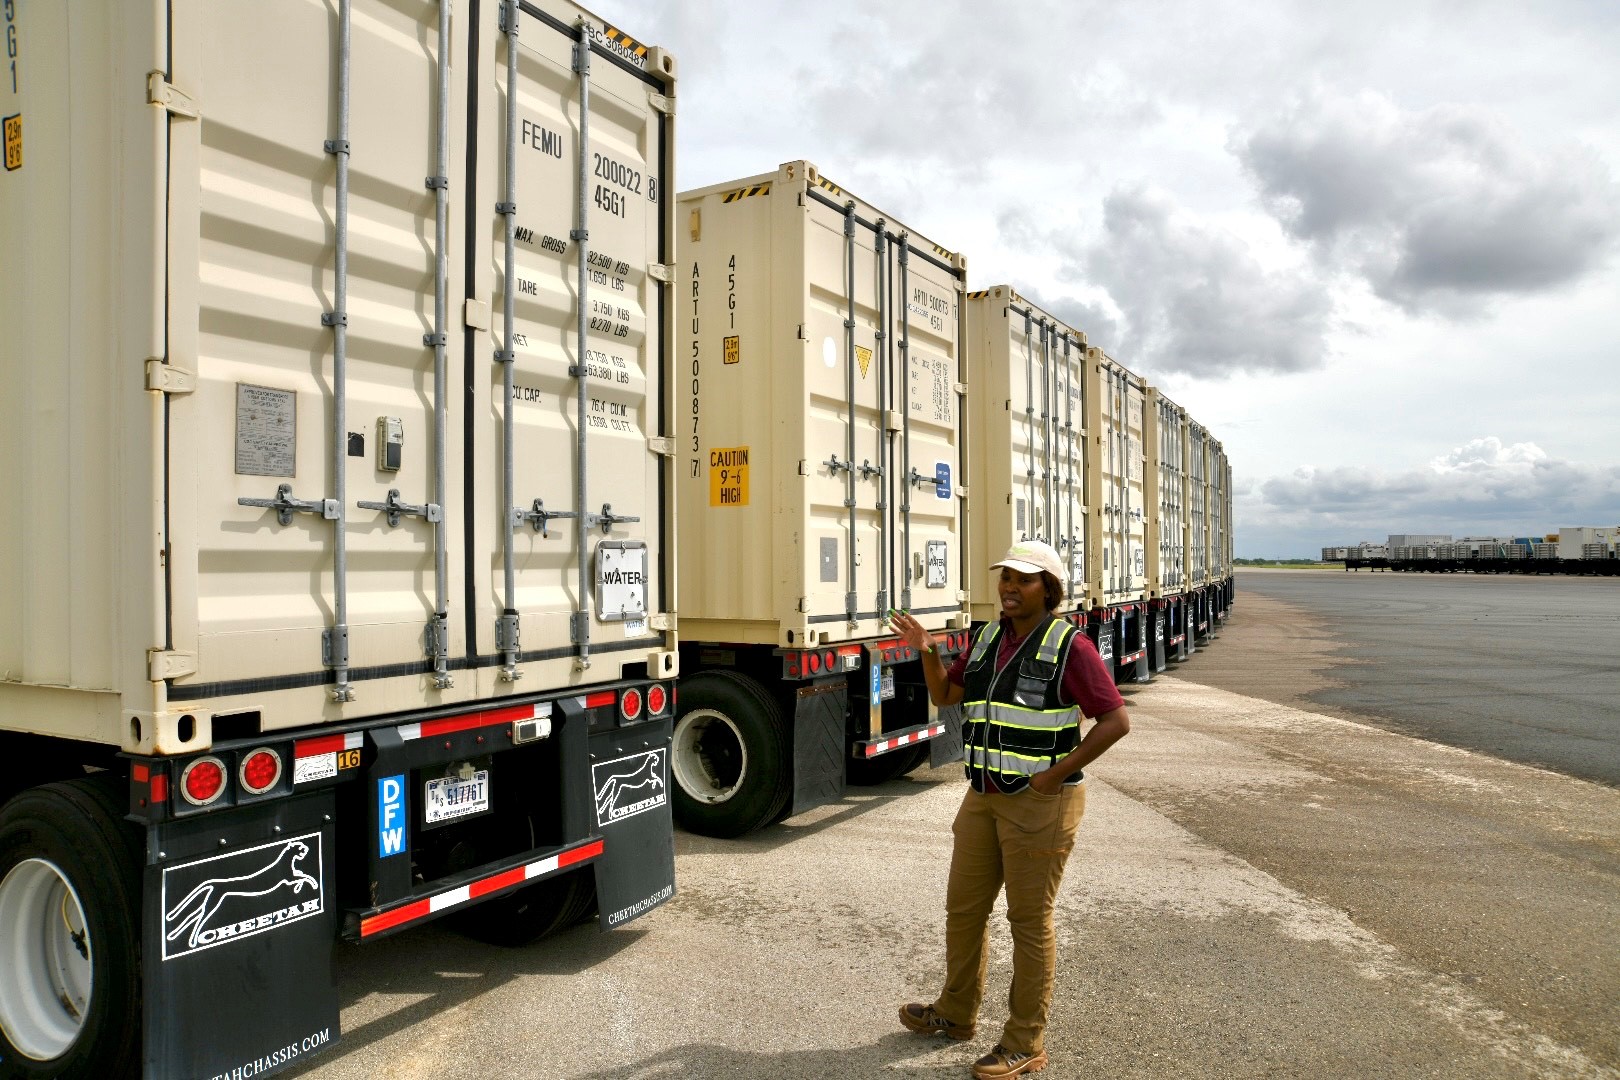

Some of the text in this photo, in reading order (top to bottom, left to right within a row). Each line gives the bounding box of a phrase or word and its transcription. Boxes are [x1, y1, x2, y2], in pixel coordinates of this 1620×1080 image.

[605, 36, 645, 68] 3080487
[522, 118, 562, 159] FEMU
[594, 152, 656, 201] 200022 8
[594, 184, 625, 219] 45G1
[514, 225, 567, 254] MAX. GROSS
[615, 260, 630, 276] KGS
[517, 277, 538, 296] TARE
[611, 276, 625, 292] LBS
[728, 254, 736, 329] 45G1
[614, 323, 629, 338] LBS
[616, 370, 630, 385] LBS
[692, 262, 700, 477] ARTU 500873 7
[525, 387, 542, 404] CAP.
[710, 449, 748, 467] CAUTION
[720, 486, 741, 503] HIGH
[604, 570, 641, 585] WATER
[339, 750, 359, 769] 16
[447, 782, 483, 806] 51776T
[612, 793, 665, 818] CHEETAH
[382, 779, 403, 854] DFW
[608, 884, 673, 925] CHEETAHCHASSIS.COM
[198, 898, 320, 944] CHEETAH
